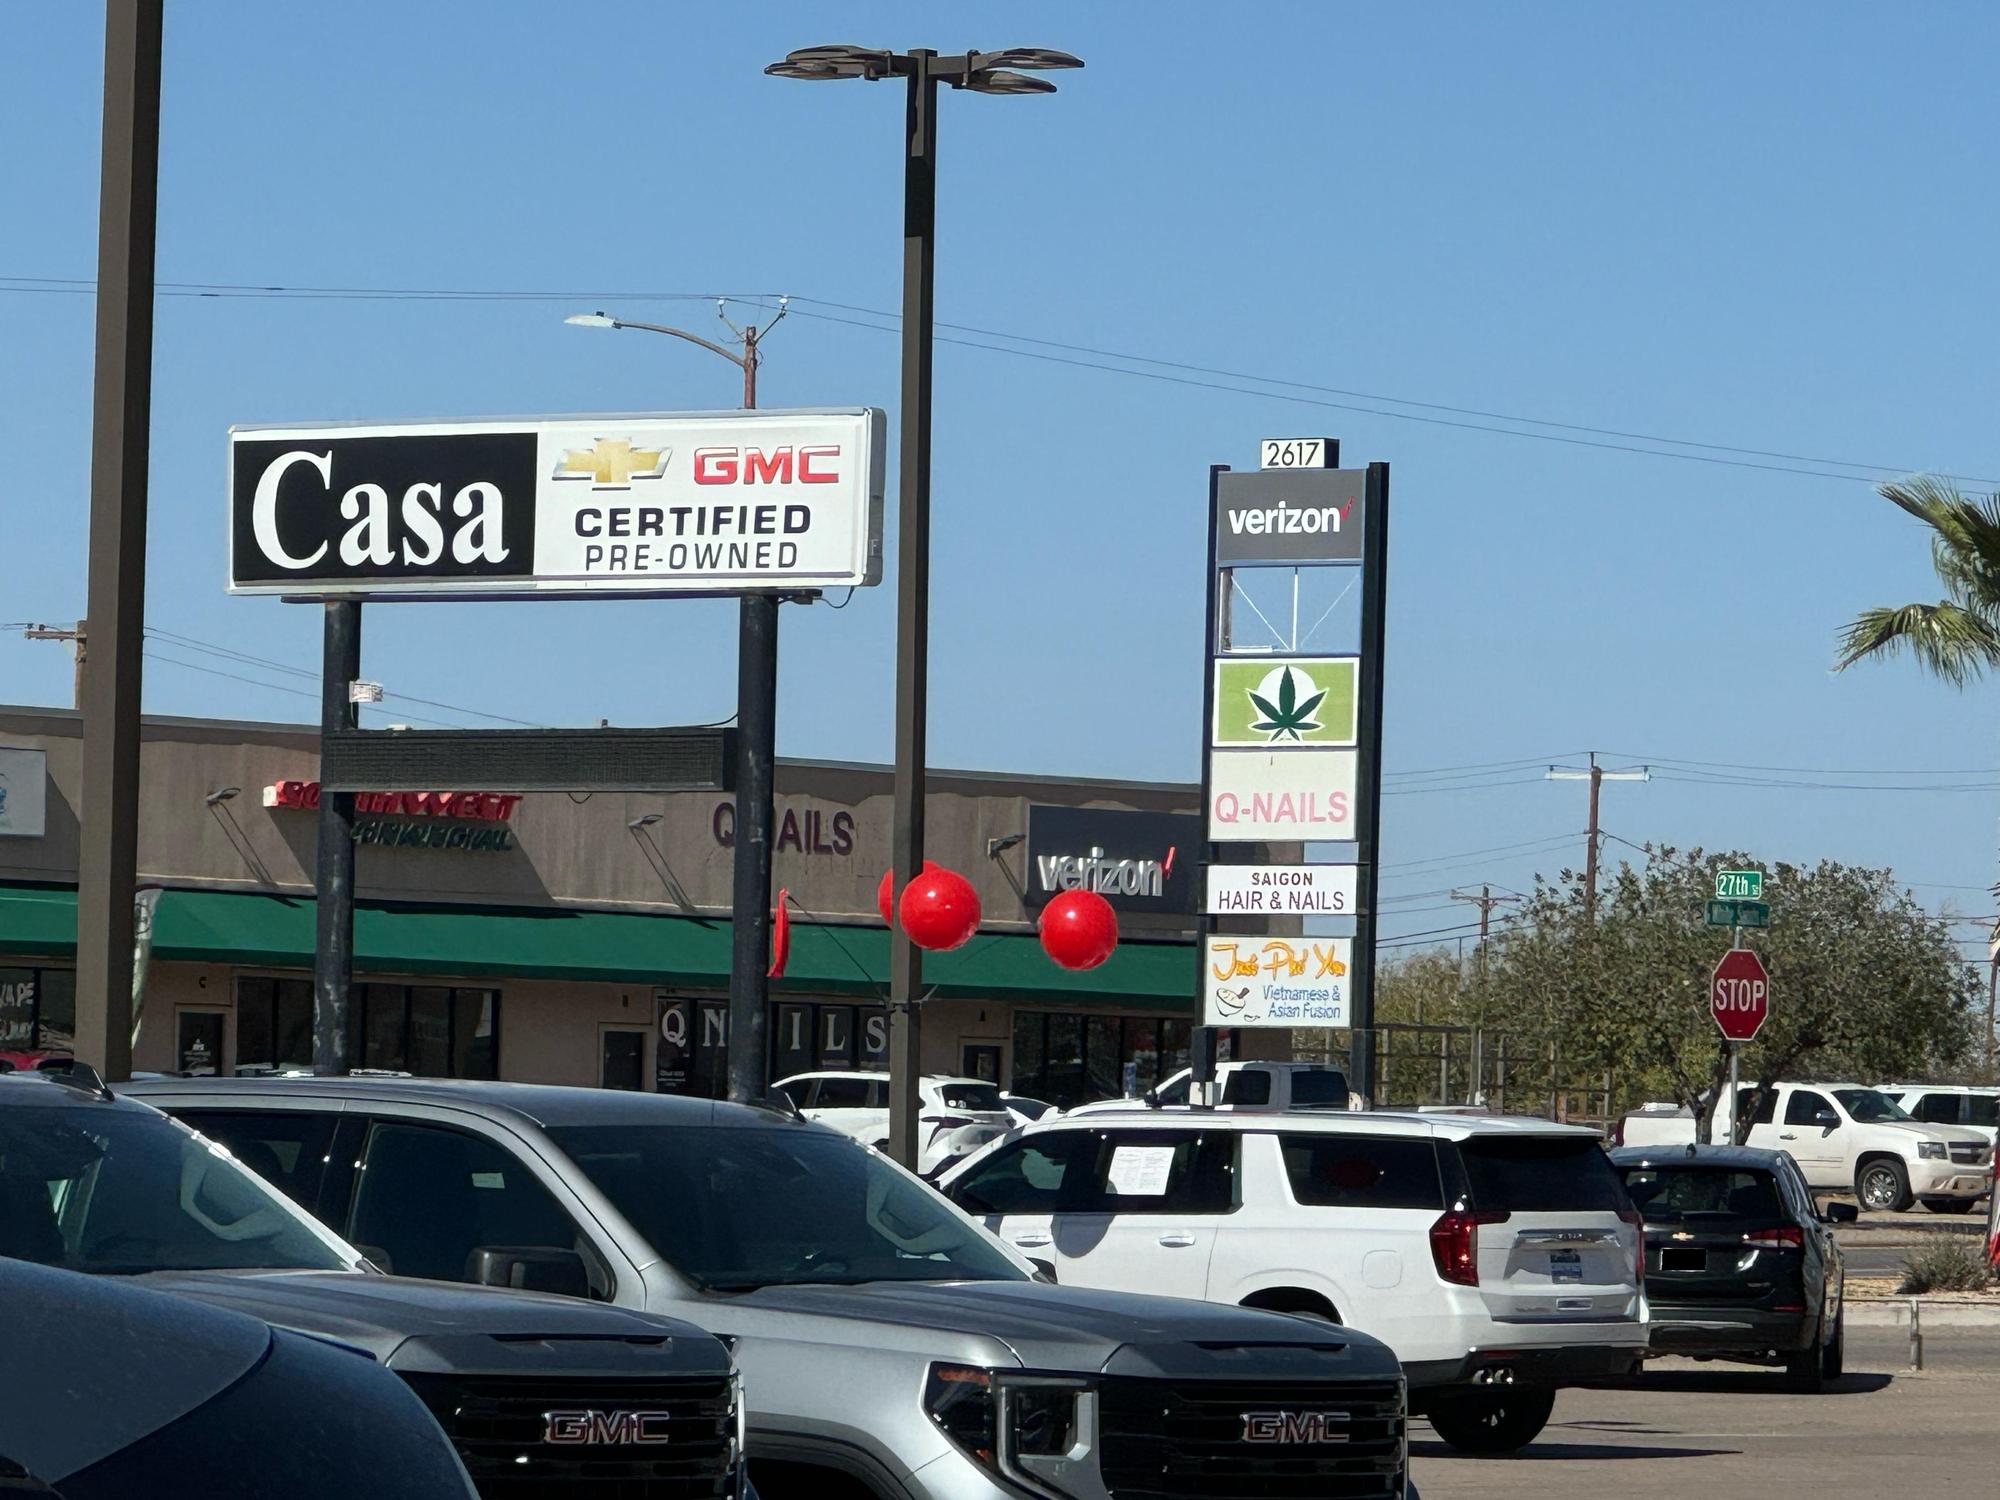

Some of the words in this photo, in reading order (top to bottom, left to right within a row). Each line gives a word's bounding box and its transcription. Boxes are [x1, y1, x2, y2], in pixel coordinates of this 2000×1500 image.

[694, 445, 841, 485] GMC
[1267, 442, 1320, 467] 2617
[252, 450, 510, 570] Casa
[575, 505, 811, 537] CERTIFIED
[1228, 500, 1341, 534] verizon
[586, 542, 797, 571] PRE-OWNED
[1215, 791, 1348, 823] Q-NAILS
[774, 808, 855, 855] AILS
[1037, 846, 1163, 897] verizon
[1252, 872, 1313, 886] SAIGON
[1719, 875, 1748, 896] 27th
[1219, 891, 1263, 910] HAIR
[1270, 891, 1282, 910] &
[1289, 891, 1344, 910] NAILS
[1263, 985, 1330, 1001] Vietnamese
[1333, 985, 1341, 1001] &
[1715, 978, 1765, 1012] STOP
[1268, 1002, 1300, 1019] Asian
[1303, 1002, 1341, 1019] Fusion
[702, 1008, 886, 1054] NILS
[541, 1409, 670, 1445] GMC
[1240, 1410, 1350, 1444] GMC
